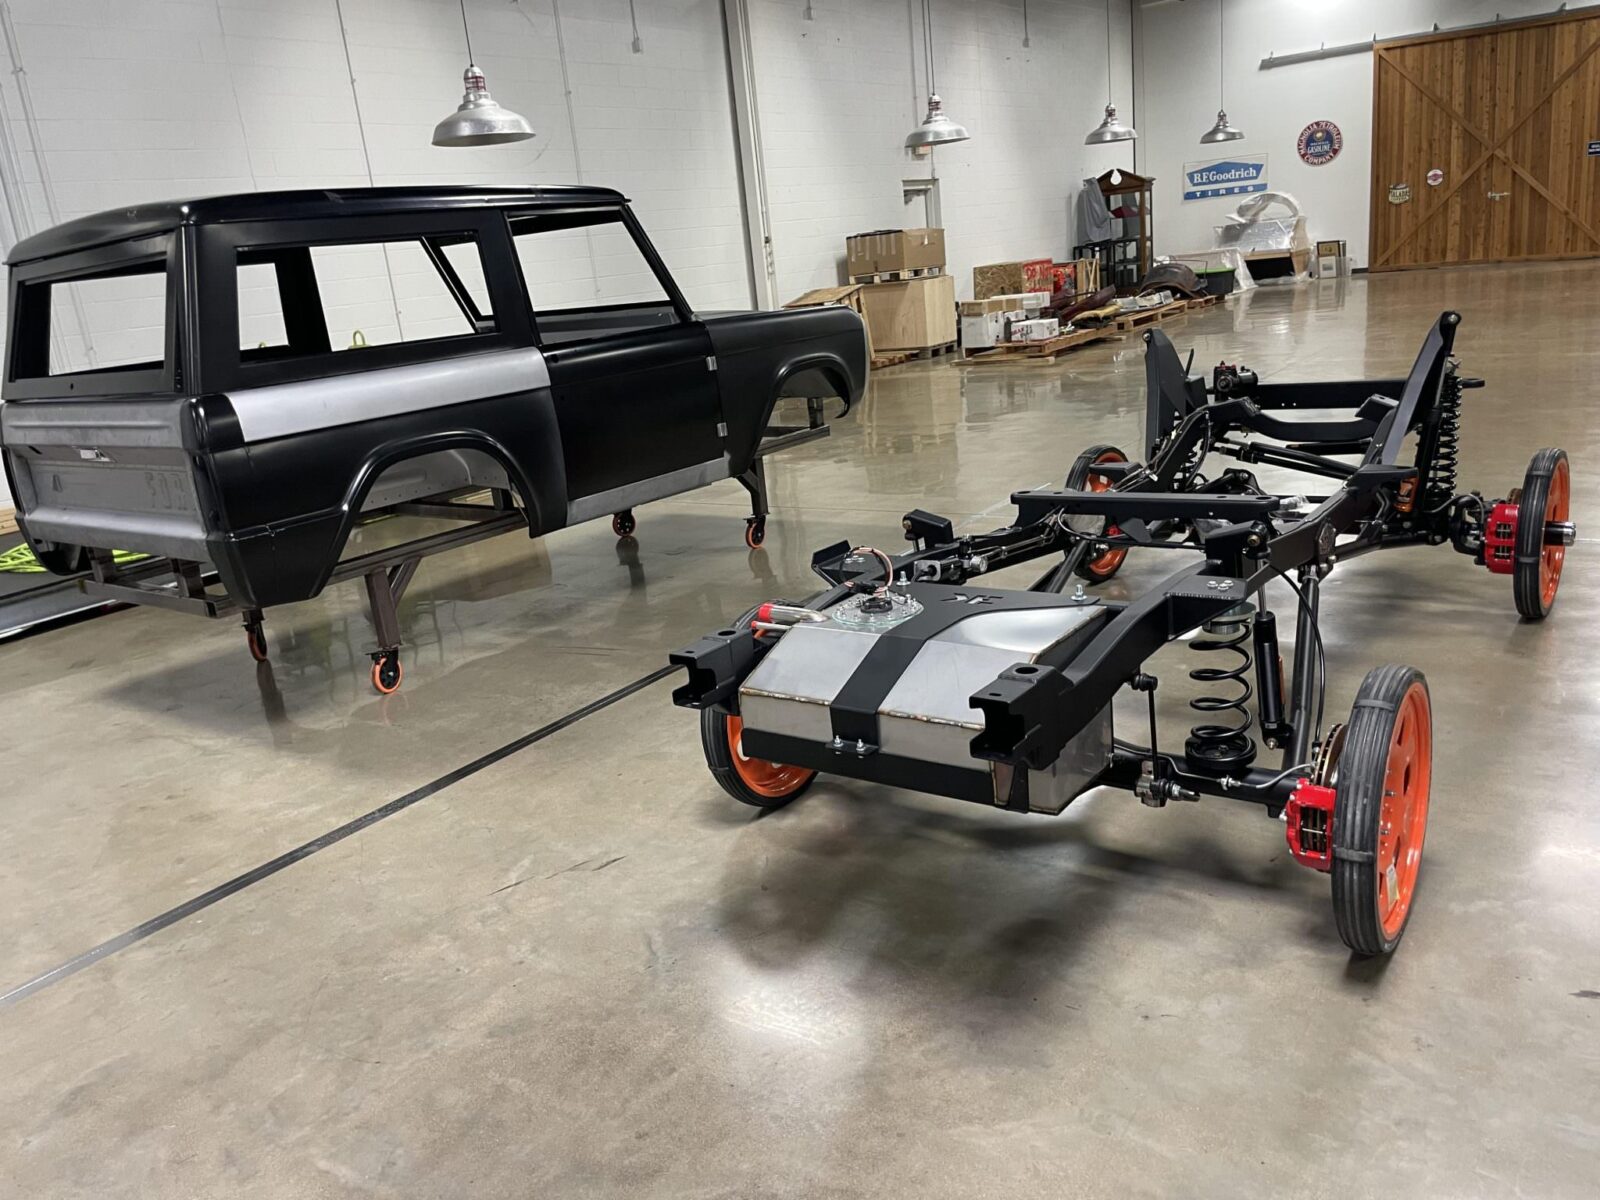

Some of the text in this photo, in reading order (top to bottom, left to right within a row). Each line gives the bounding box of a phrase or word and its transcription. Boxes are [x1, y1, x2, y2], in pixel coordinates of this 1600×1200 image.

[1298, 121, 1341, 155] MAGNOLIA PETROLEUM
[1307, 143, 1331, 154] GASOLINE
[1304, 152, 1335, 165] COMPANY
[1195, 185, 1254, 197] TIRES
